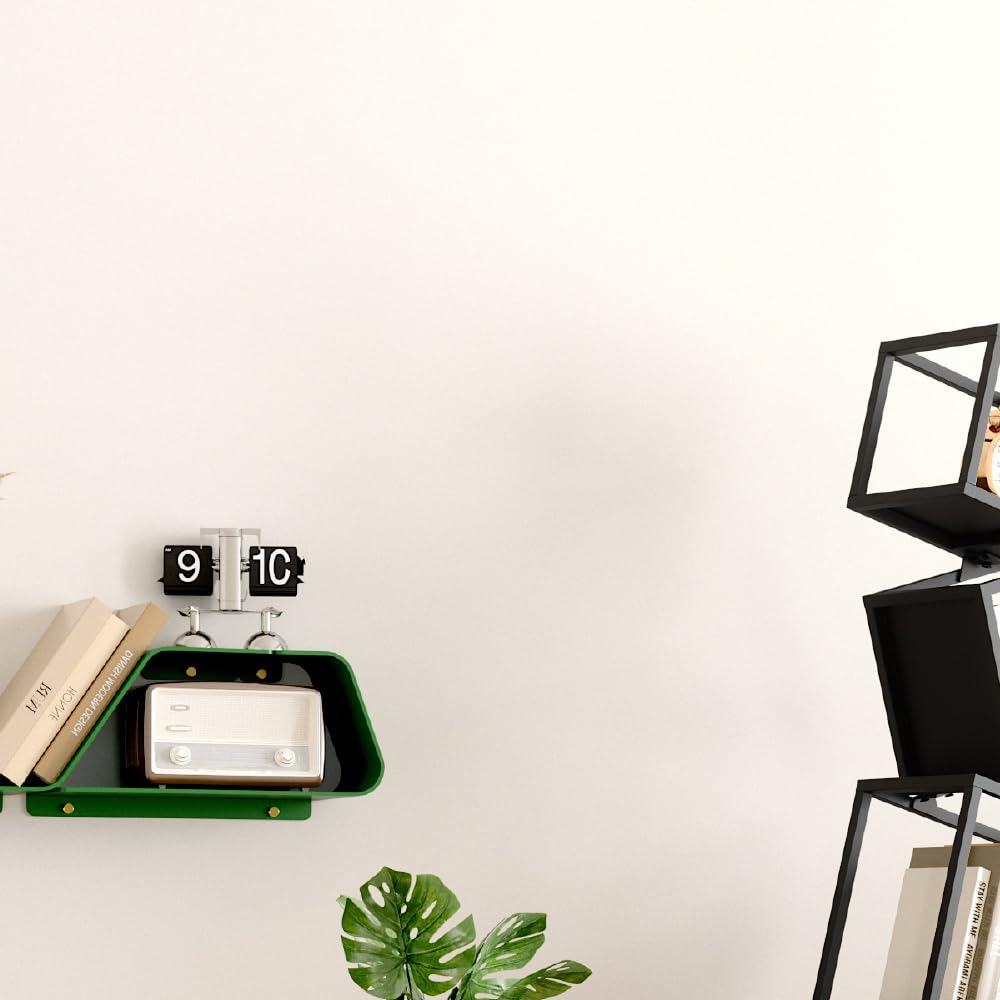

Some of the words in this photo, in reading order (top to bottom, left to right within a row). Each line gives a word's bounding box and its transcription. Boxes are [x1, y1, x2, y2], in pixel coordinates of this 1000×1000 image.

[177, 549, 201, 583] 9
[976, 881, 986, 900] STAY
[972, 902, 982, 923] WITH
